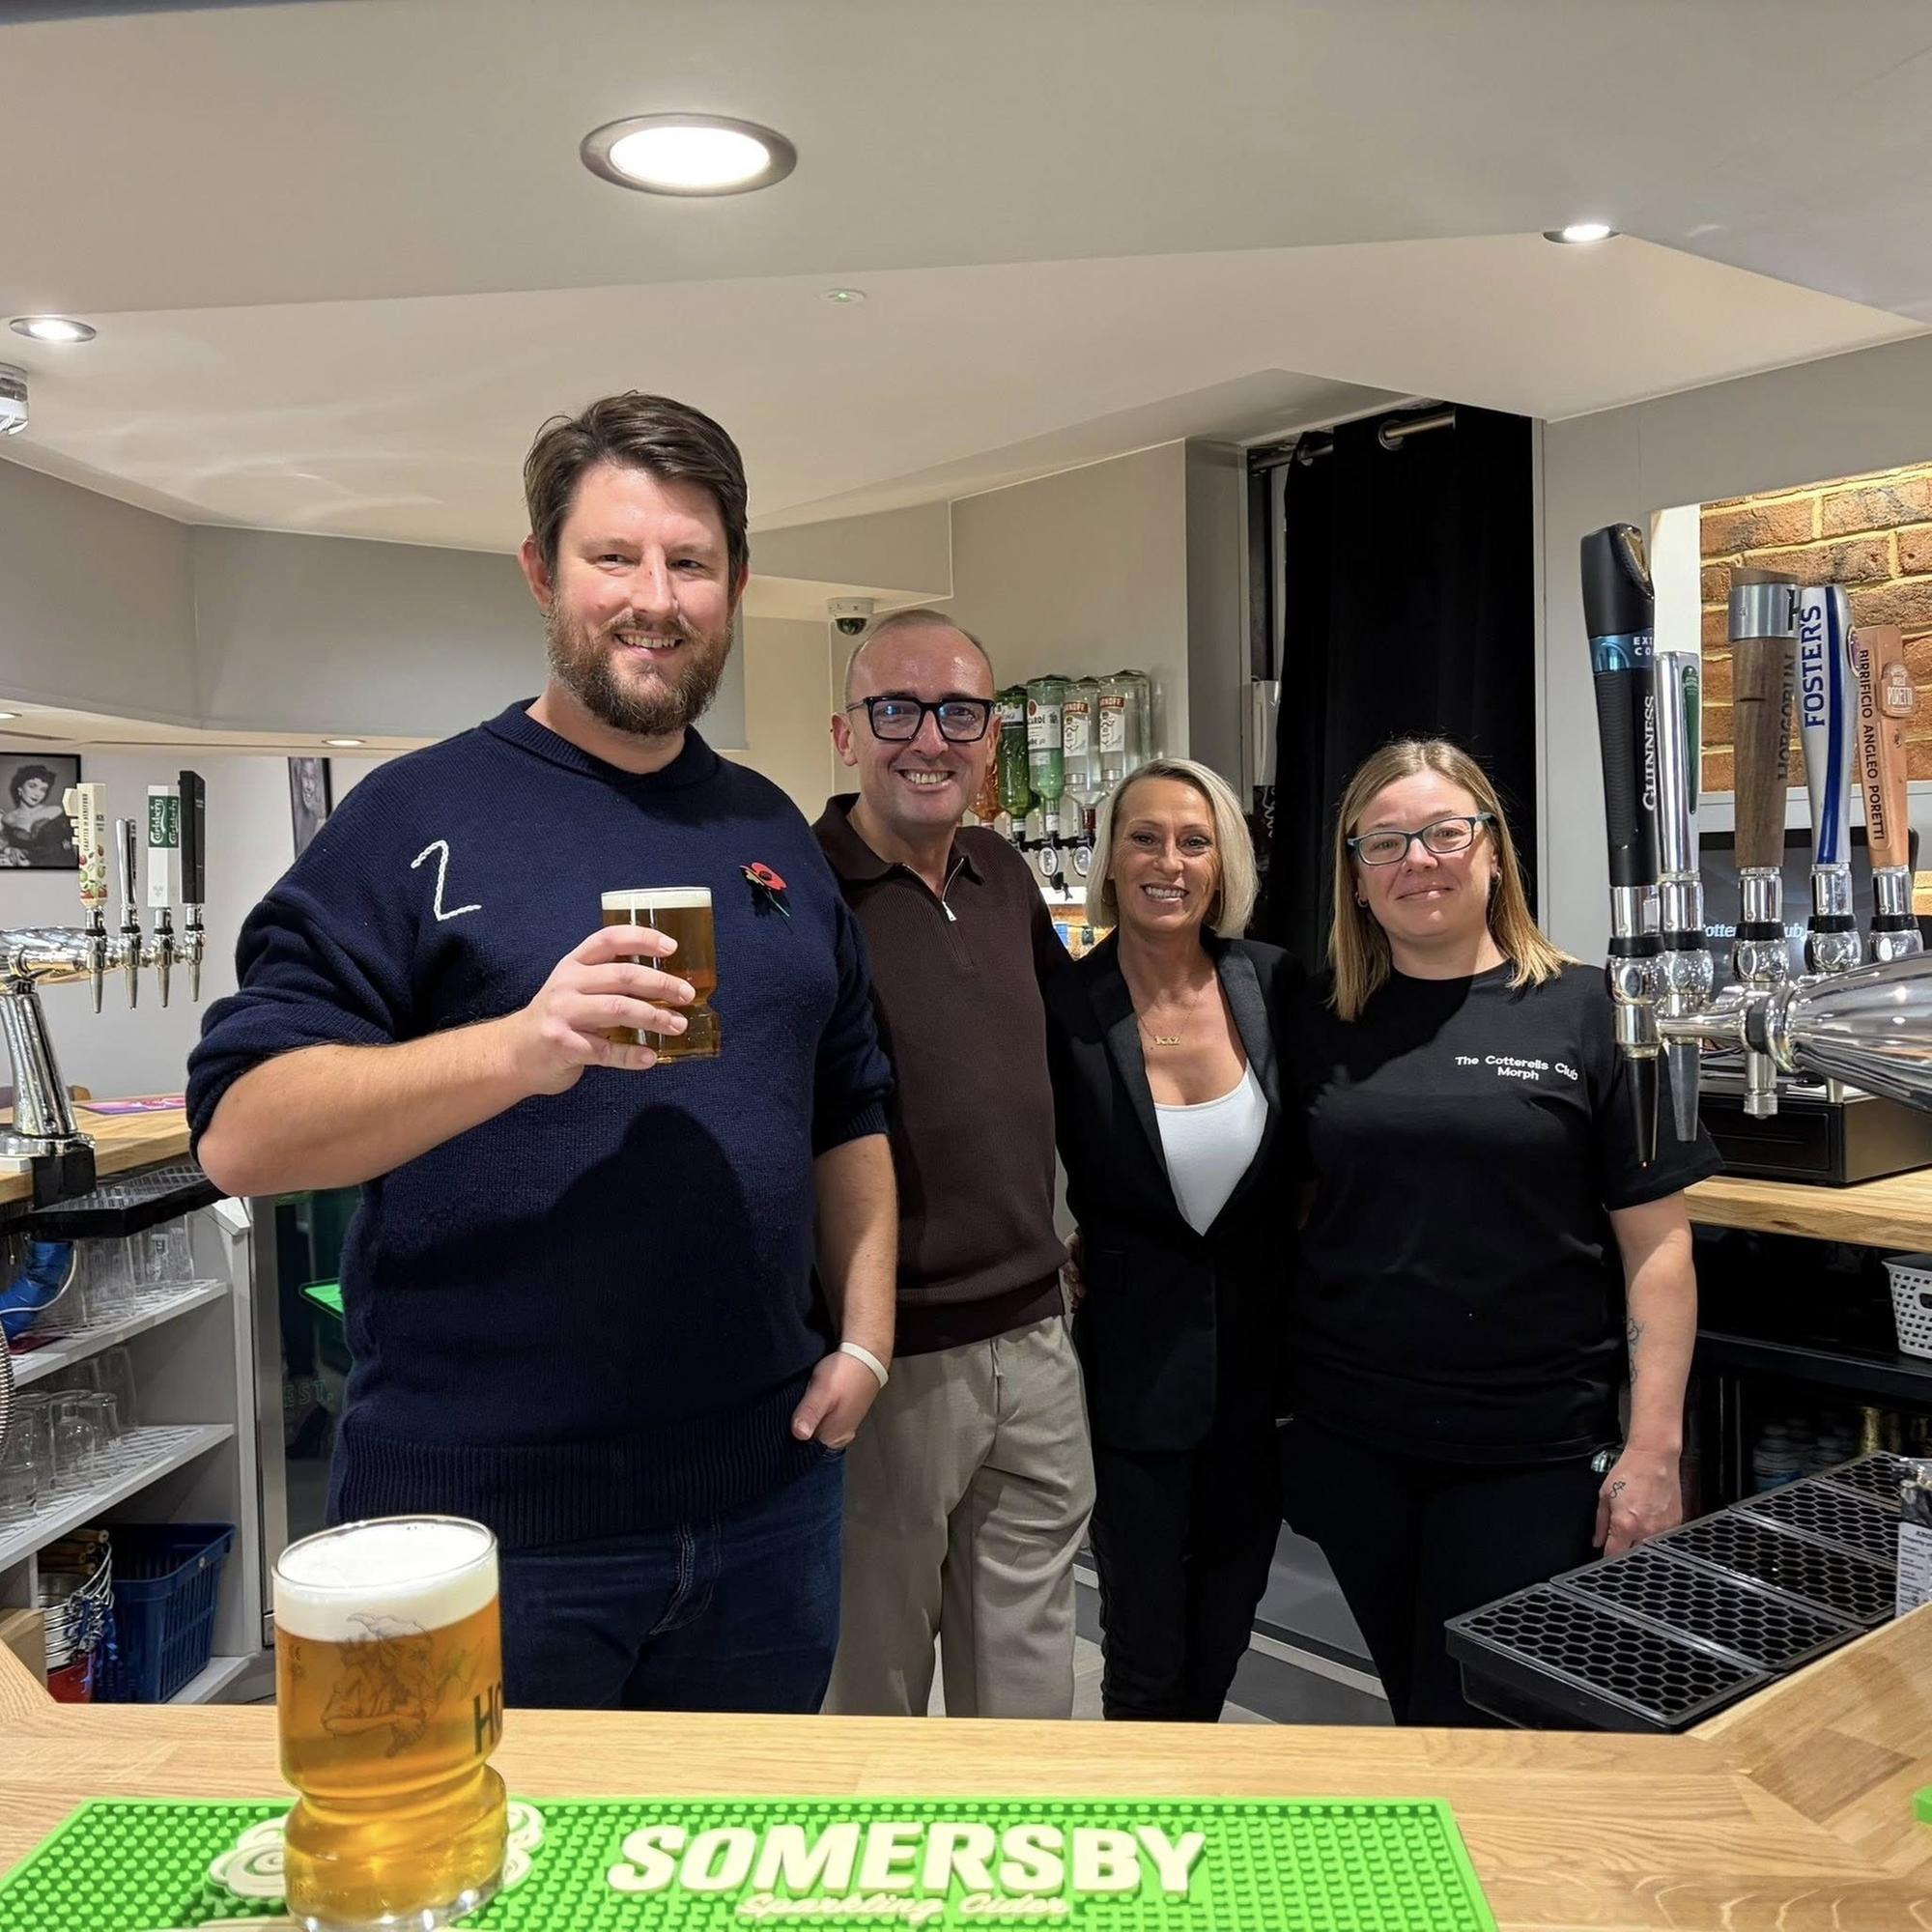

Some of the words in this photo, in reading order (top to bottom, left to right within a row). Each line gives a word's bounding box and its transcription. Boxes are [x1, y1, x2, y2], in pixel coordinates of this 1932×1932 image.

[1800, 605, 1826, 728] FOSTER'S
[1642, 696, 1656, 811] GUINNESS
[150, 799, 166, 844] Carlsberg
[1868, 785, 1885, 840] PORETTI
[1455, 1056, 1480, 1065] The
[1485, 1055, 1548, 1070] Cotterells
[1554, 1063, 1578, 1081] Club
[1497, 1066, 1540, 1081] Morph
[607, 1821, 1207, 1898] SOMERSBY
[735, 1891, 945, 1926] Sparkling
[960, 1890, 1067, 1918] Cider
